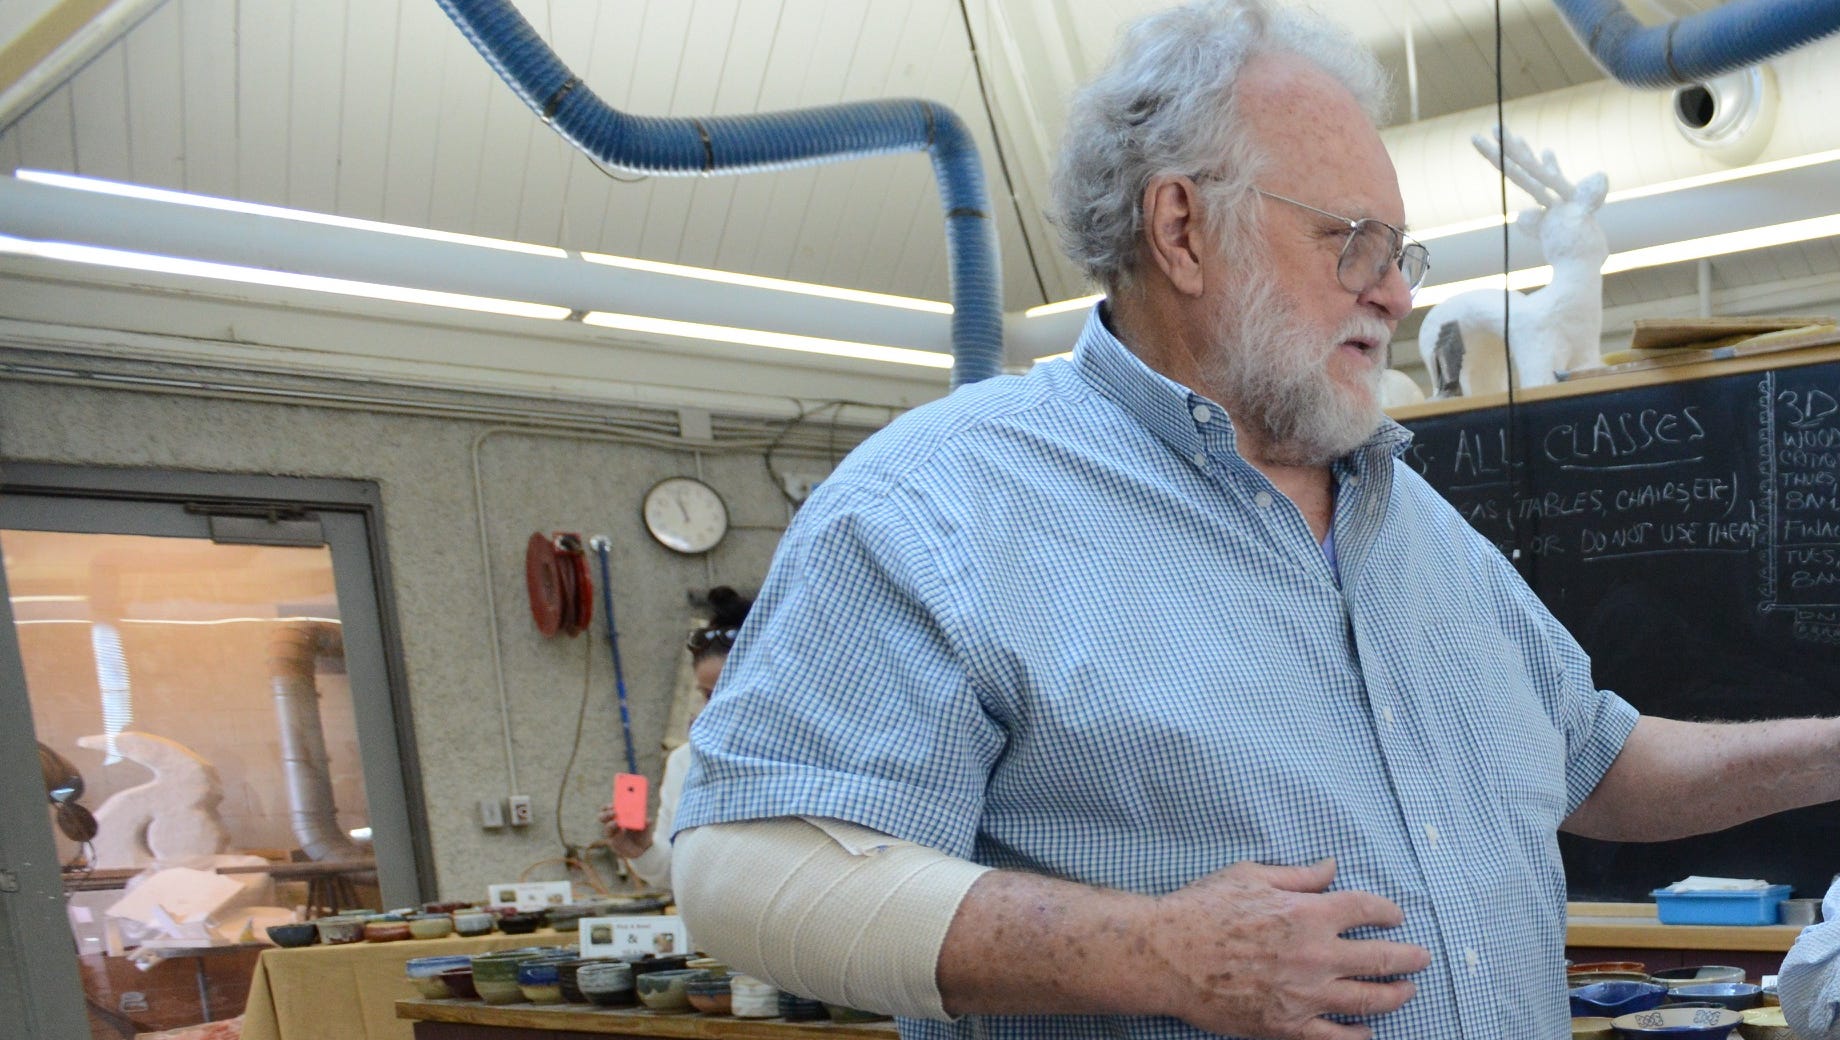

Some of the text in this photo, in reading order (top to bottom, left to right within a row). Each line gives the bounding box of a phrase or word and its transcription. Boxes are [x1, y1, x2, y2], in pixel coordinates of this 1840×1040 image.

[1778, 390, 1838, 426] 3D
[1455, 428, 1524, 477] ALL
[1544, 406, 1705, 462] CLASSES
[1531, 534, 1565, 557] OR
[1581, 528, 1607, 553] DO
[1611, 522, 1654, 548] NOT
[1661, 522, 1701, 545] USE
